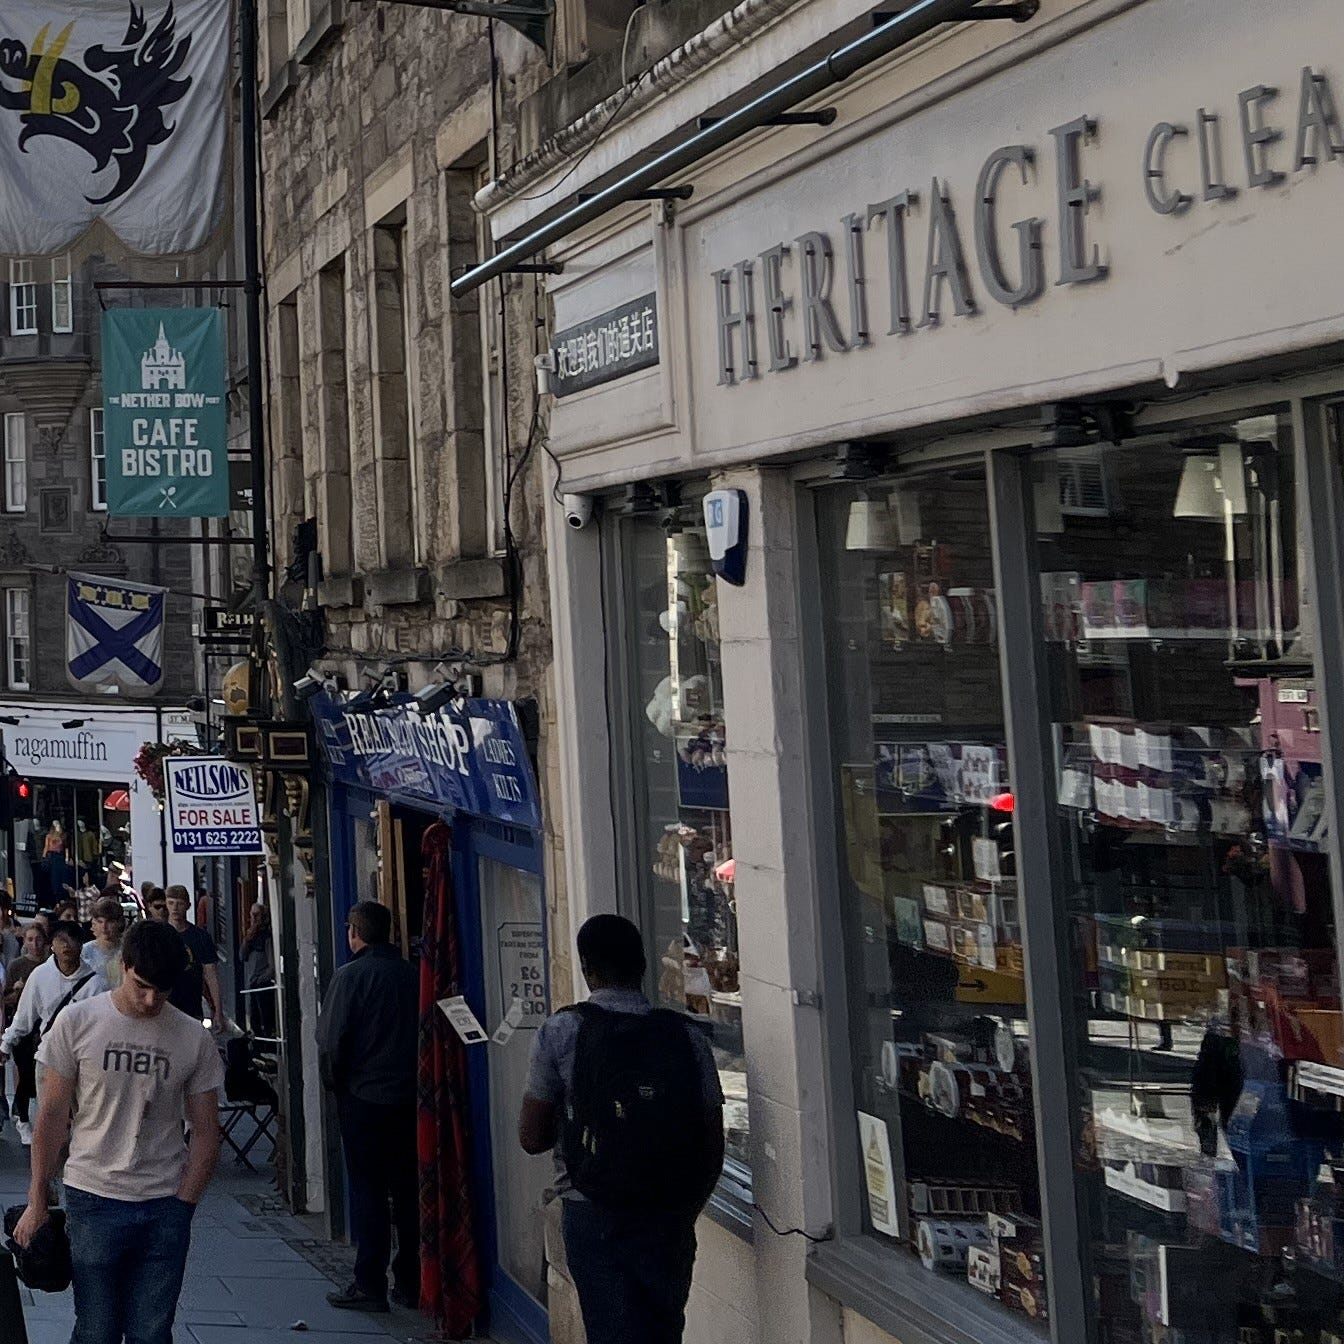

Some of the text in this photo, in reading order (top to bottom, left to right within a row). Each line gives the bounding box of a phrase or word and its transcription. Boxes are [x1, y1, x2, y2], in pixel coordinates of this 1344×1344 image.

[711, 113, 1104, 387] HERITAGE
[556, 306, 654, 380] 欢迎到我们的通关店
[121, 393, 170, 408] NETHER
[174, 392, 205, 408] BOW
[133, 418, 198, 446] CAFE
[121, 449, 212, 477] BISTRO
[15, 732, 108, 766] ragamuffin
[342, 712, 390, 756] REAL
[418, 718, 470, 777] SHOP
[485, 738, 516, 767] LADIES
[174, 764, 250, 795] NEILSONS
[492, 773, 522, 803] KILTS
[179, 809, 252, 826] FOR SALE
[174, 831, 260, 846] 0131 625 2222
[510, 983, 544, 998] 2 FO
[102, 1048, 171, 1080] man
